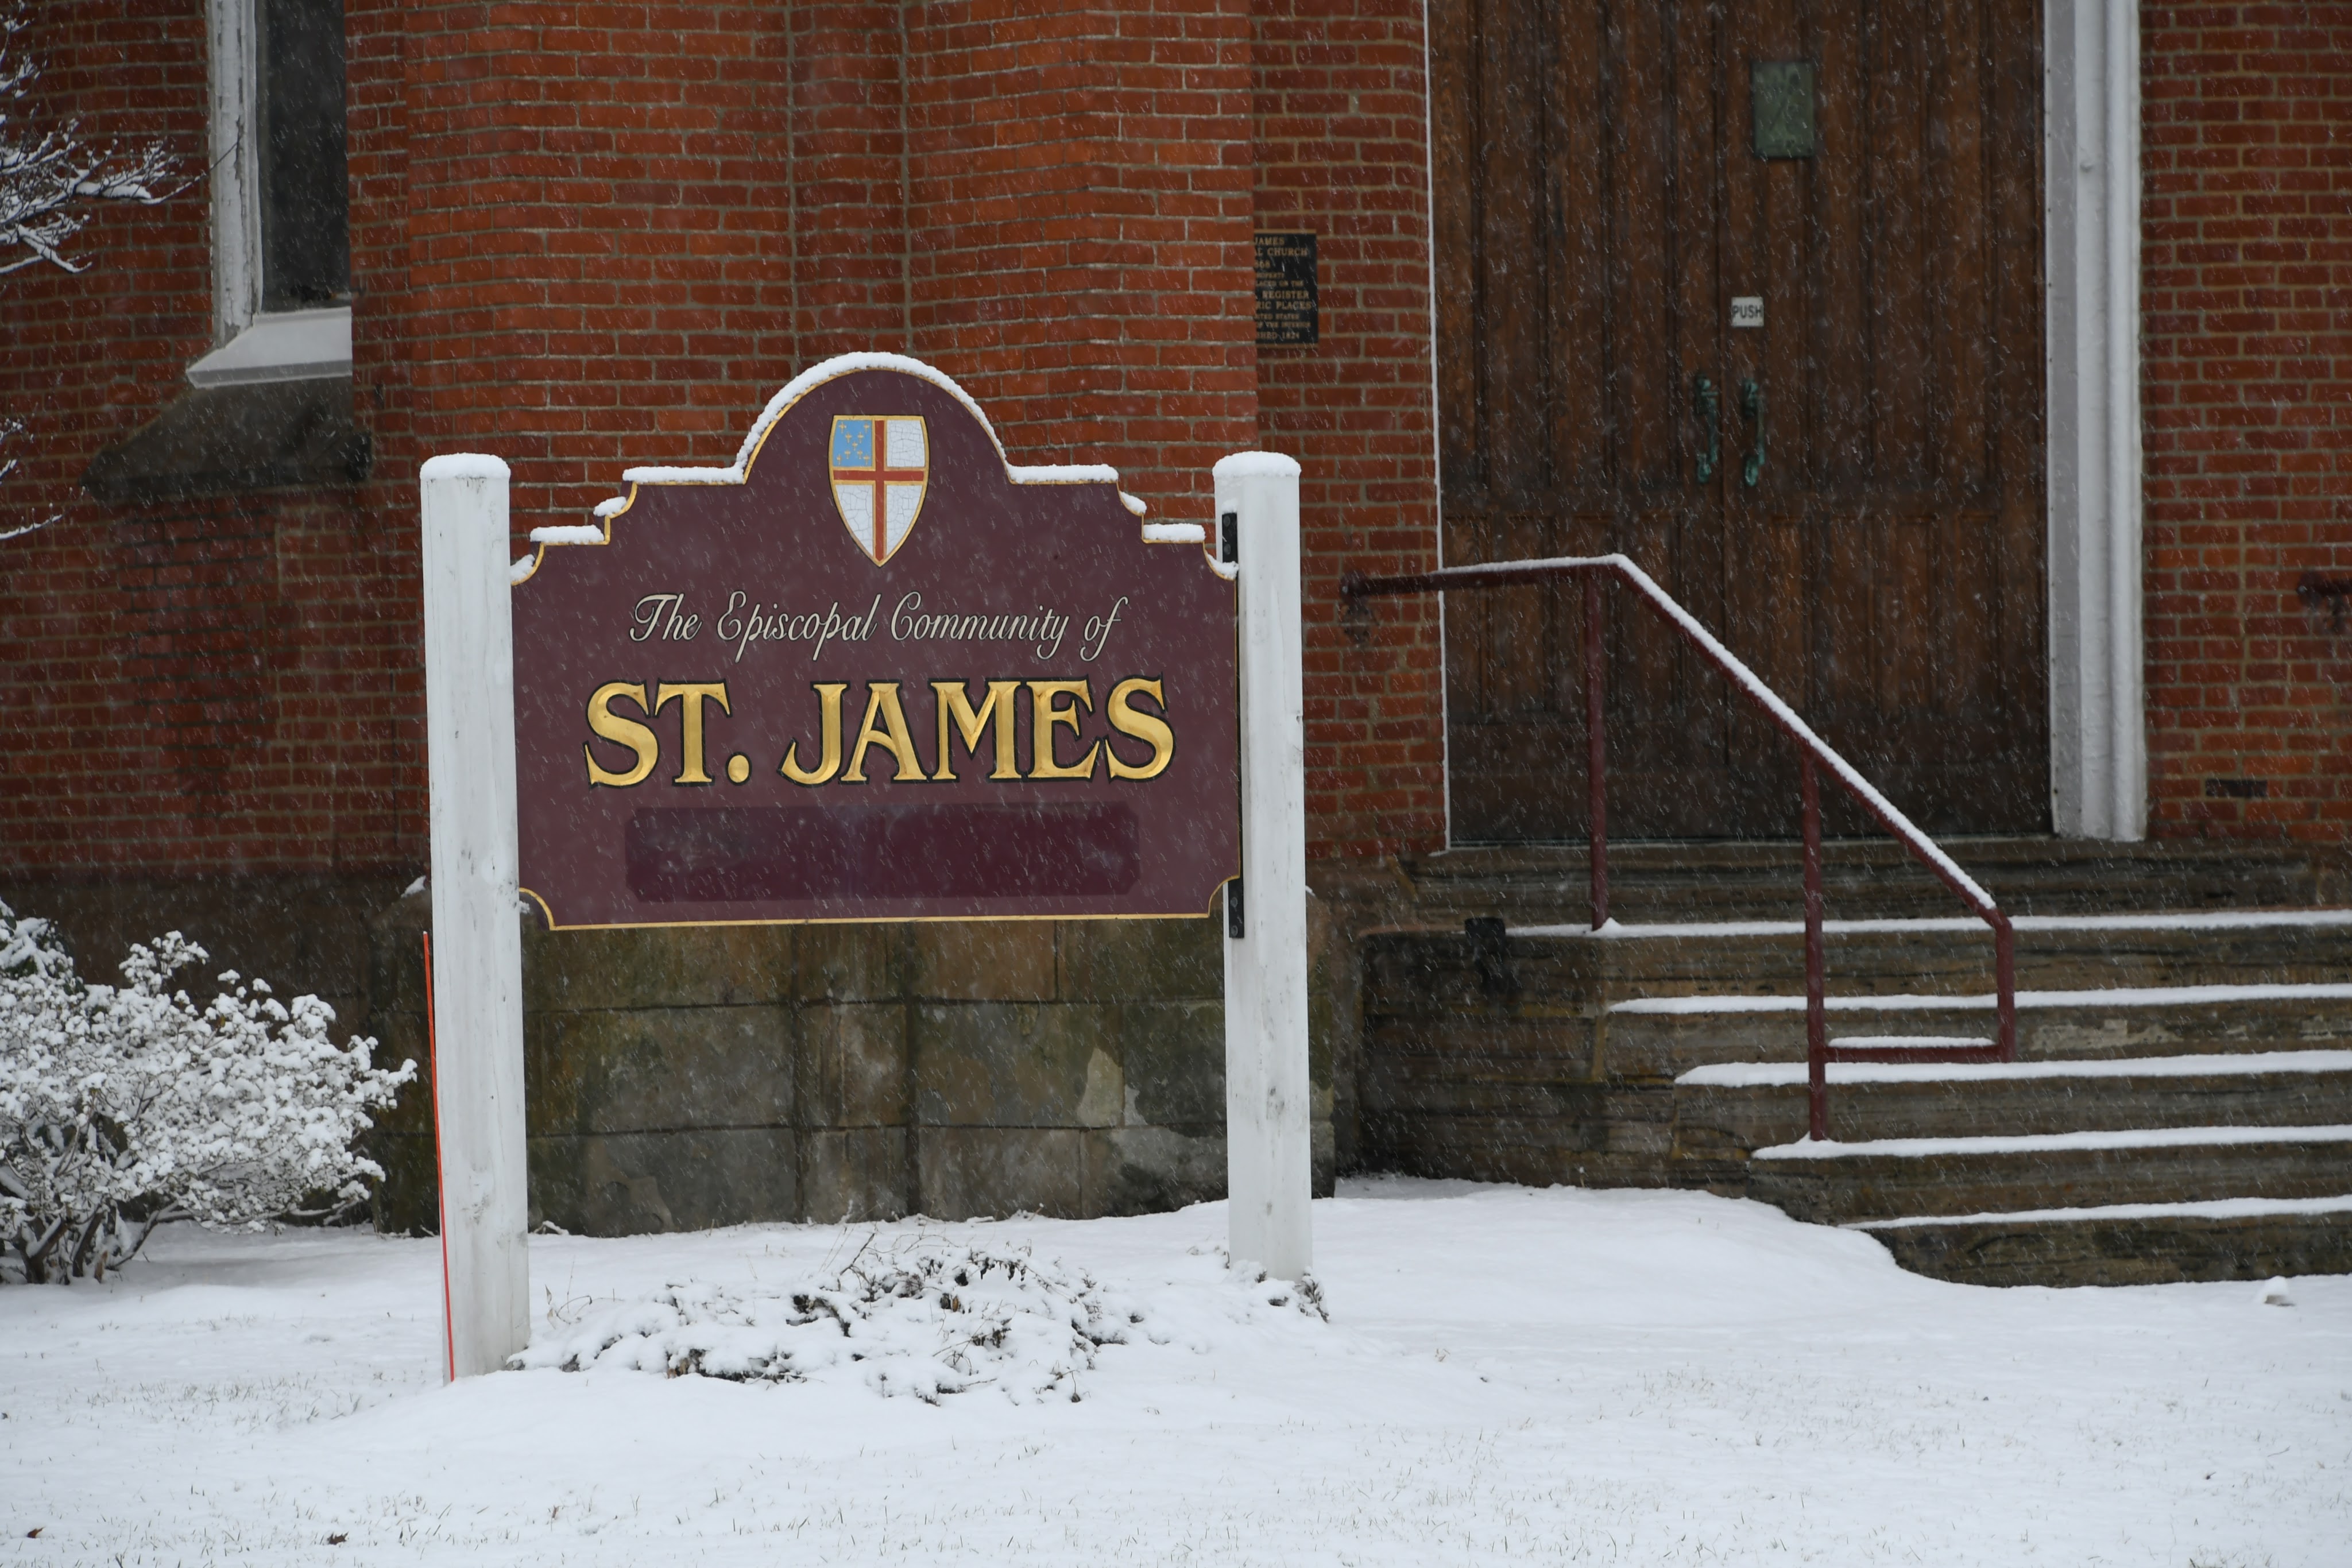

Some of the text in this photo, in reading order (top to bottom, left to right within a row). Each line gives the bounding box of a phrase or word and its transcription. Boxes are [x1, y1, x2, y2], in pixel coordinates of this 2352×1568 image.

[1255, 237, 1285, 246] JAMES
[1267, 247, 1308, 257] CHURCH
[1262, 290, 1309, 299] REGISTER
[1276, 301, 1312, 310] PLACES
[1732, 305, 1763, 319] PUSH
[630, 590, 1129, 664] The Episcopal Community of
[583, 672, 1177, 789] ST. JAMES
